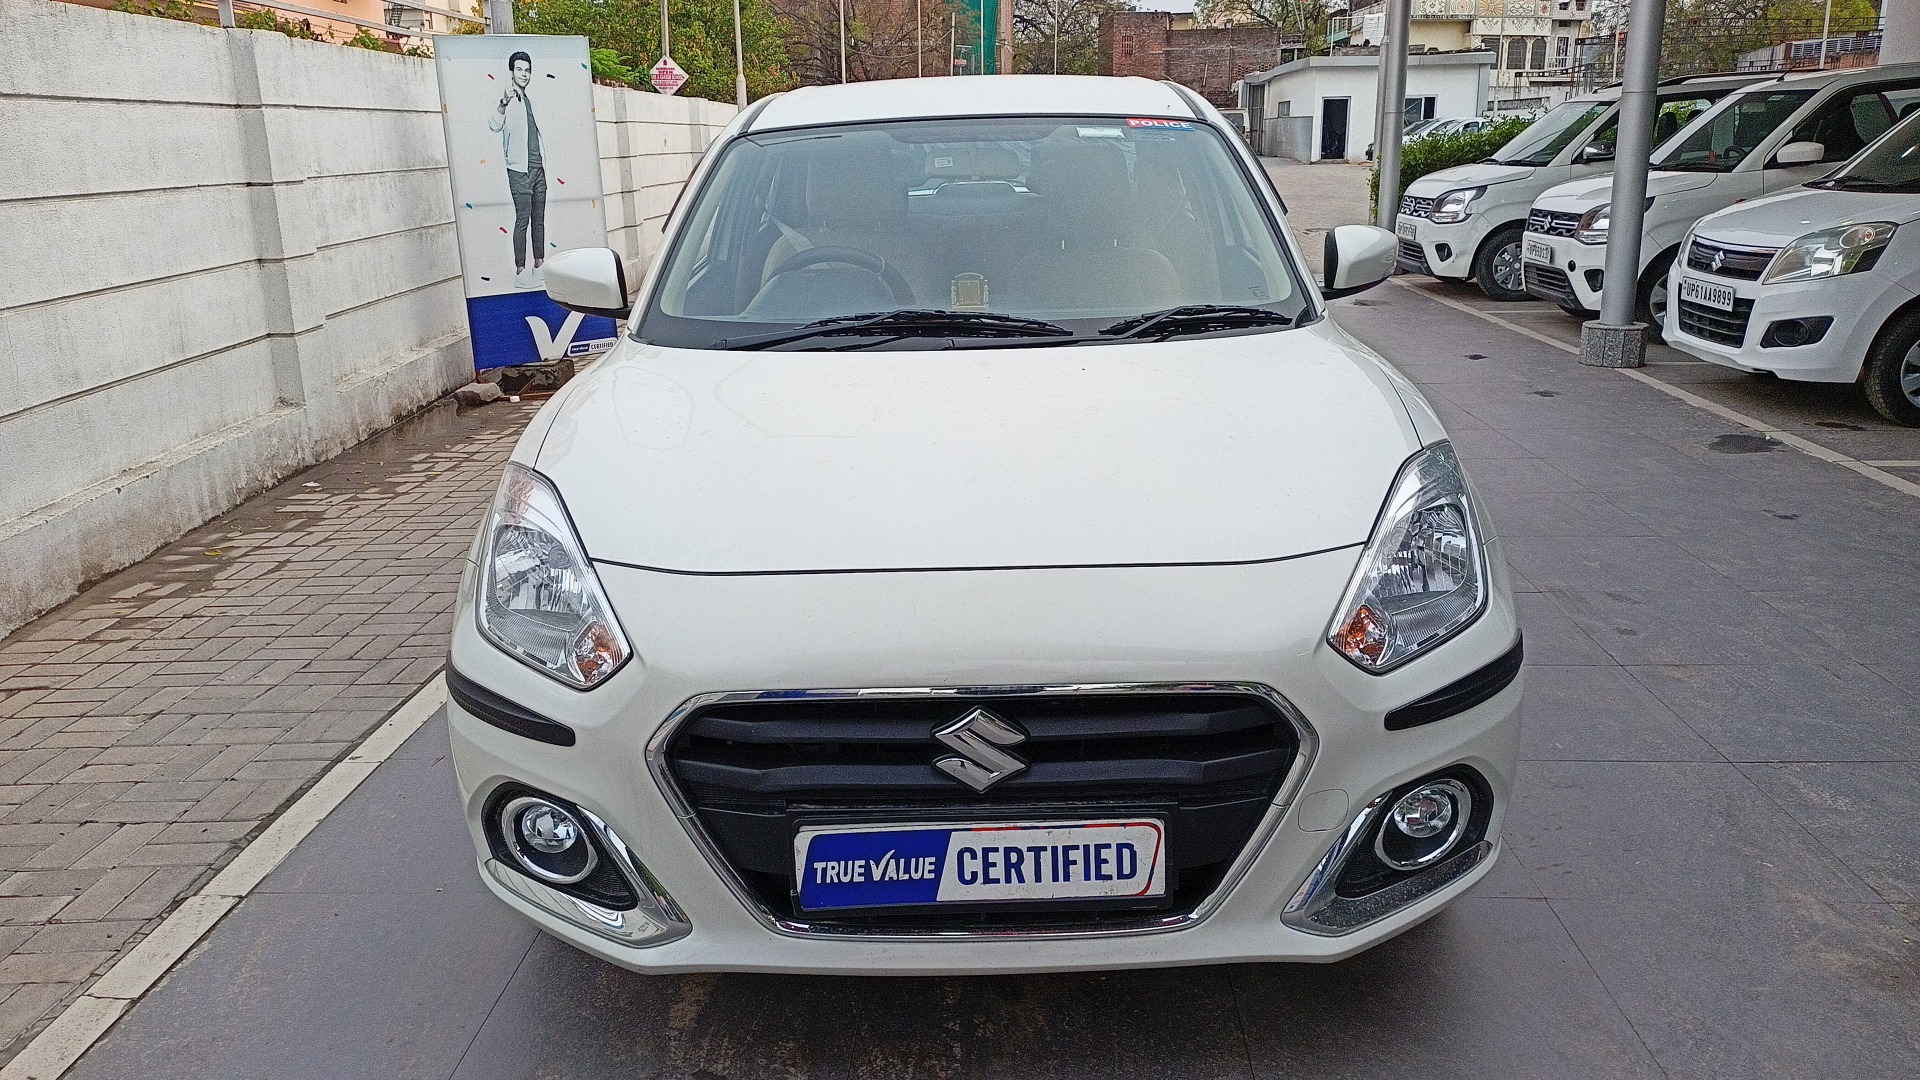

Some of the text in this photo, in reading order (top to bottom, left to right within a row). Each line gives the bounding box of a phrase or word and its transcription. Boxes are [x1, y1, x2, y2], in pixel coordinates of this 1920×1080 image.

[1129, 119, 1193, 129] POLICE
[1686, 281, 1732, 306] UP61AA9899
[590, 341, 614, 350] CERTIFIED
[814, 842, 1138, 886] TRUE VALUE CERTIFIED
